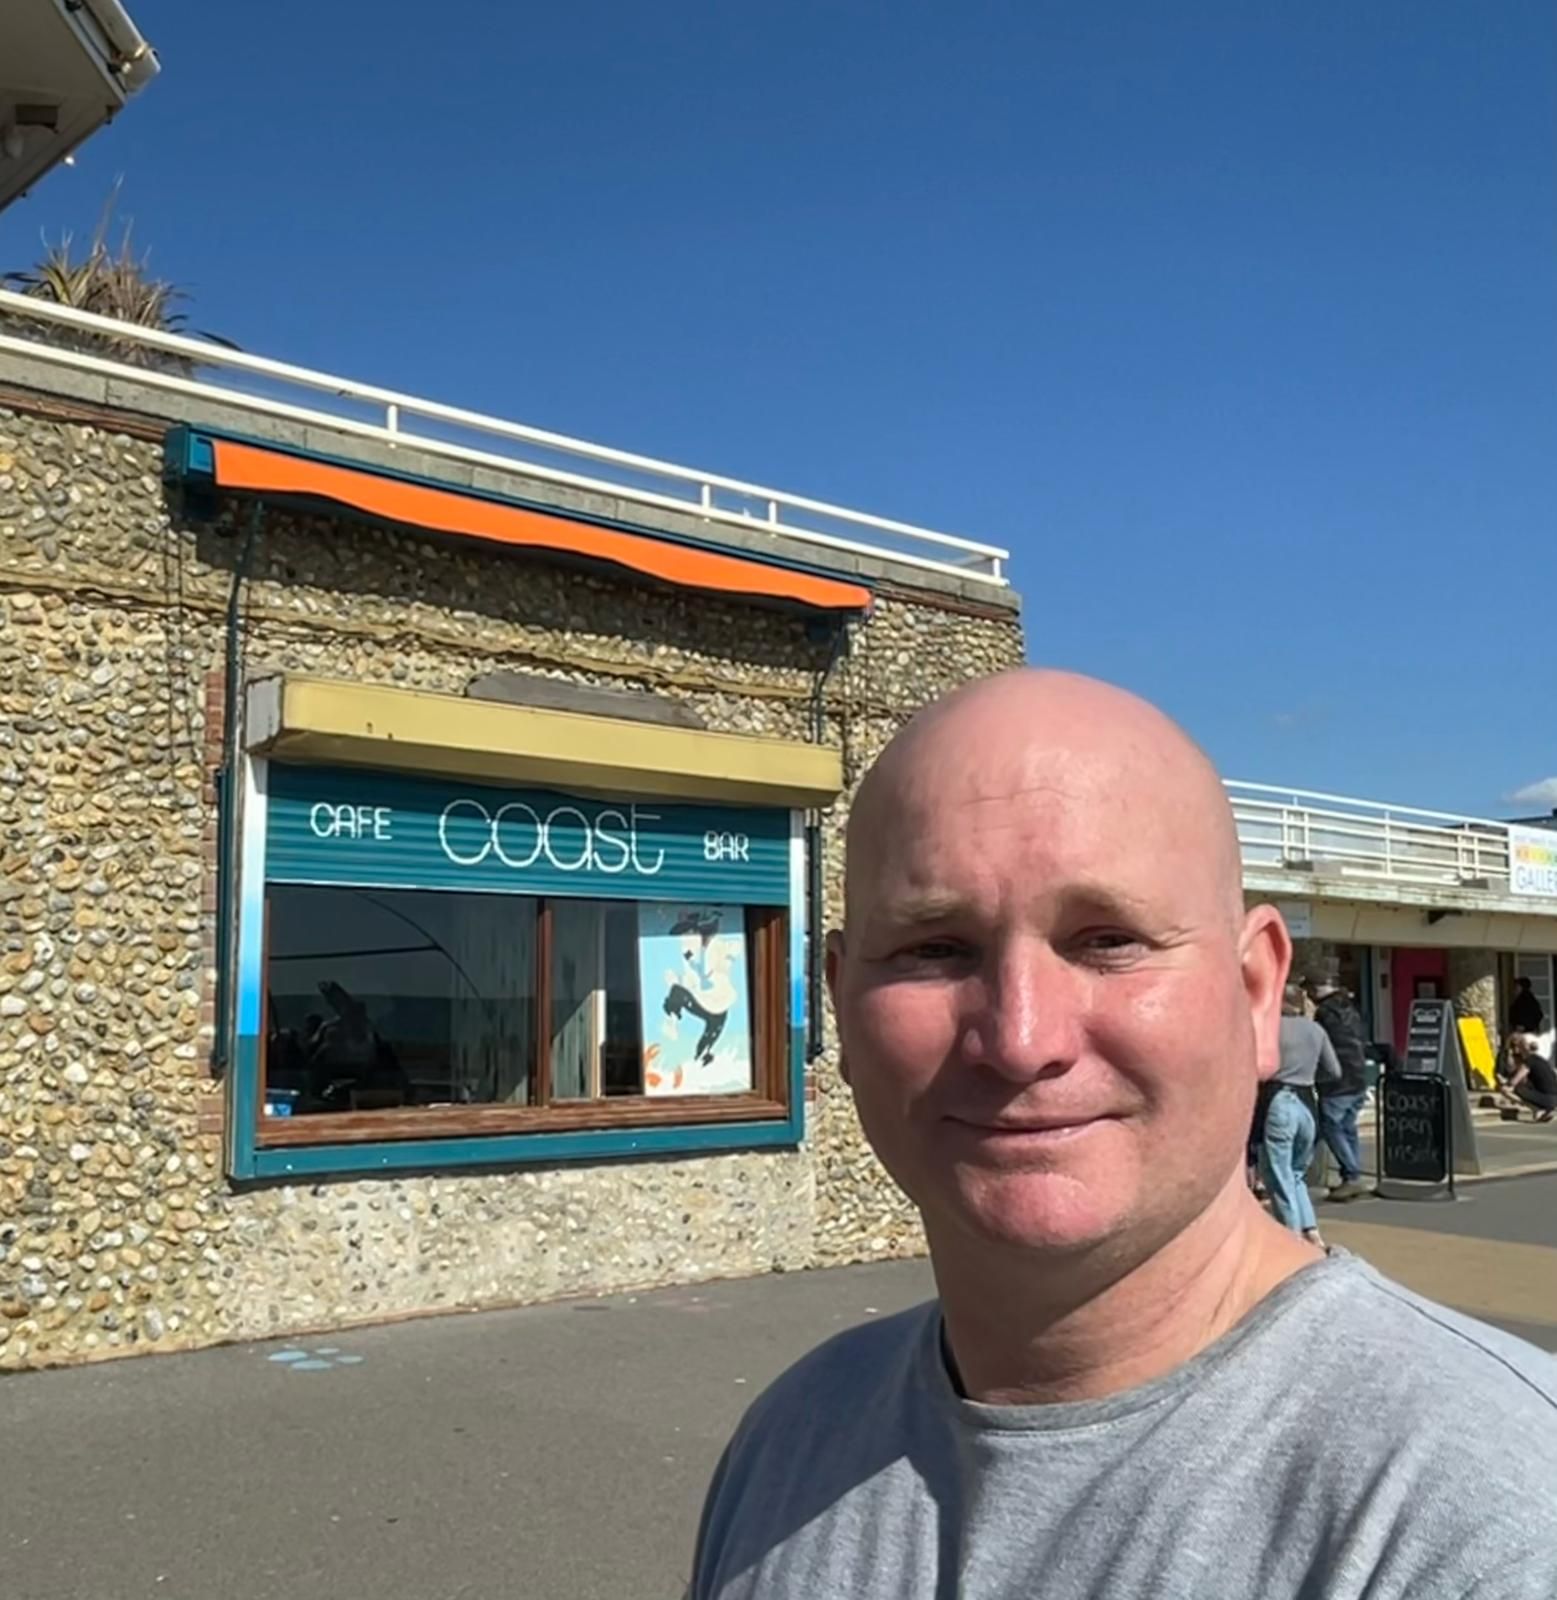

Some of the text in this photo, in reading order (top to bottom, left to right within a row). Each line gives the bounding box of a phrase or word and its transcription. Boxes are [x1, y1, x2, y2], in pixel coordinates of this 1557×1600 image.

[310, 802, 392, 840] CAFE
[703, 830, 749, 862] BAR
[1516, 866, 1557, 892] GALLE
